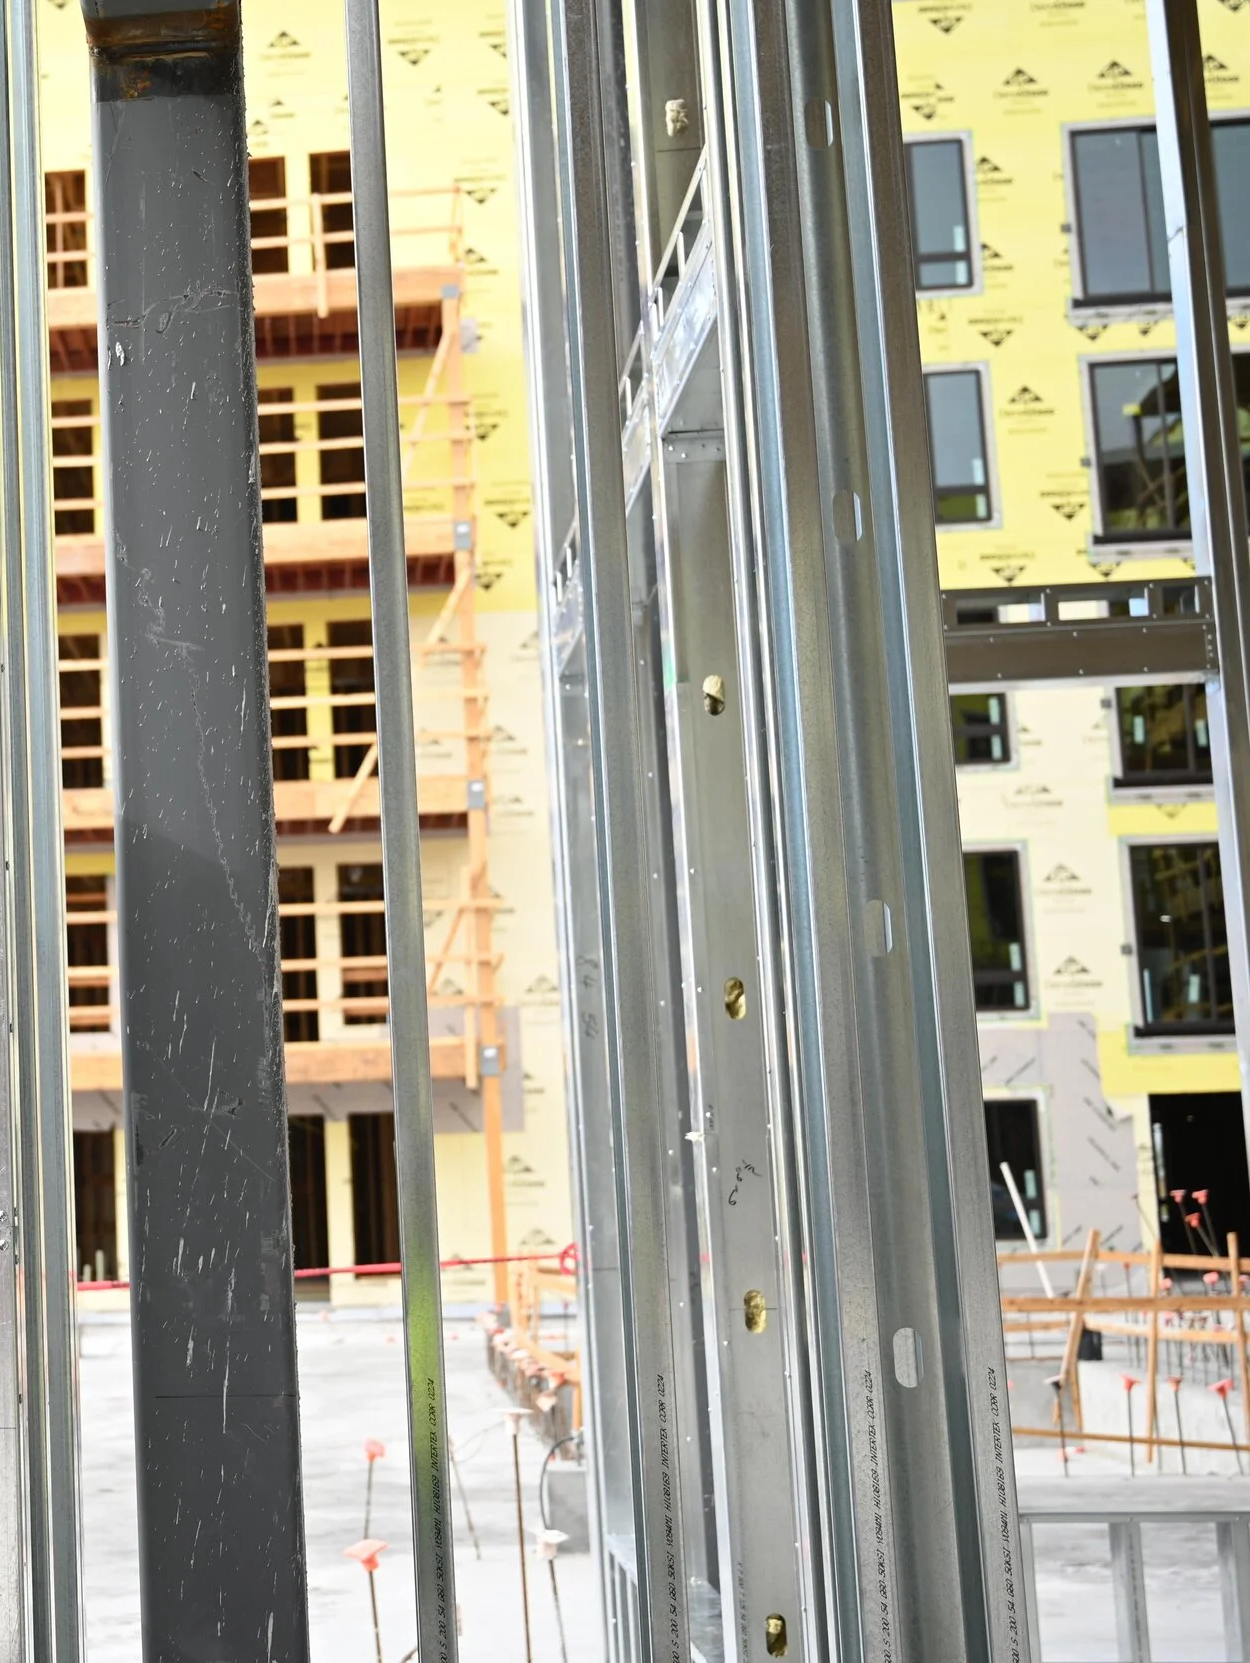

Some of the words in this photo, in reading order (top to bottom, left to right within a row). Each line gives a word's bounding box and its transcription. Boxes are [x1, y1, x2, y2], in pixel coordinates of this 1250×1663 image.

[656, 1374, 665, 1396] 0224
[864, 1369, 872, 1393] 0224
[987, 1366, 996, 1390] 0224
[659, 1425, 668, 1468] INTERTEK
[868, 1421, 878, 1465] INTERTEK
[992, 1419, 1002, 1463] INTERTEK
[669, 1603, 677, 1616] 54
[880, 1601, 888, 1615] 54
[1007, 1599, 1015, 1613] 54
[670, 1618, 678, 1638] 200
[881, 1617, 889, 1636] 200
[1008, 1615, 1017, 1635] 200
